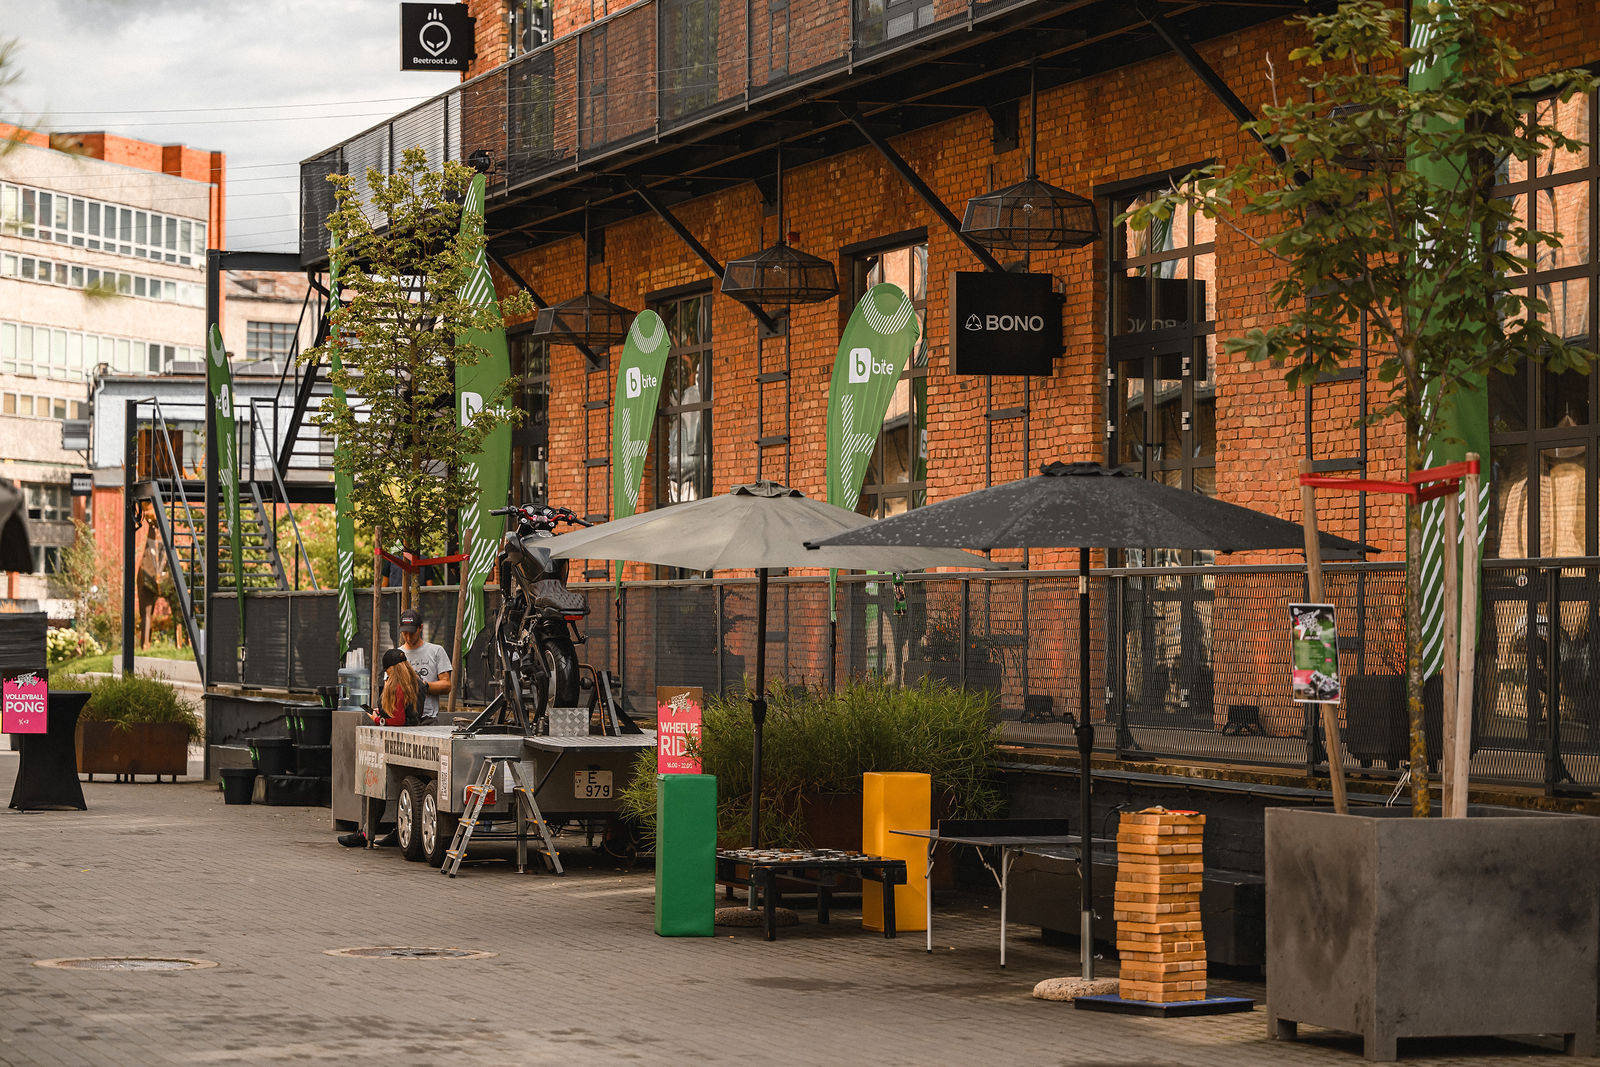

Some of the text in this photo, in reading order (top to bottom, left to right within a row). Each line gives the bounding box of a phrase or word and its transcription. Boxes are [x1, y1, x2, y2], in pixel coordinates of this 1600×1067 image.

[413, 57, 444, 65] Beetroot
[986, 315, 1044, 332] BONO
[872, 357, 894, 375] bite
[642, 374, 657, 389] bite
[5, 701, 45, 713] PONG
[660, 721, 699, 734] WHEELIE
[412, 743, 440, 762] MACHINE
[660, 735, 699, 757] RID
[588, 771, 597, 784] E
[586, 784, 610, 798] 979
